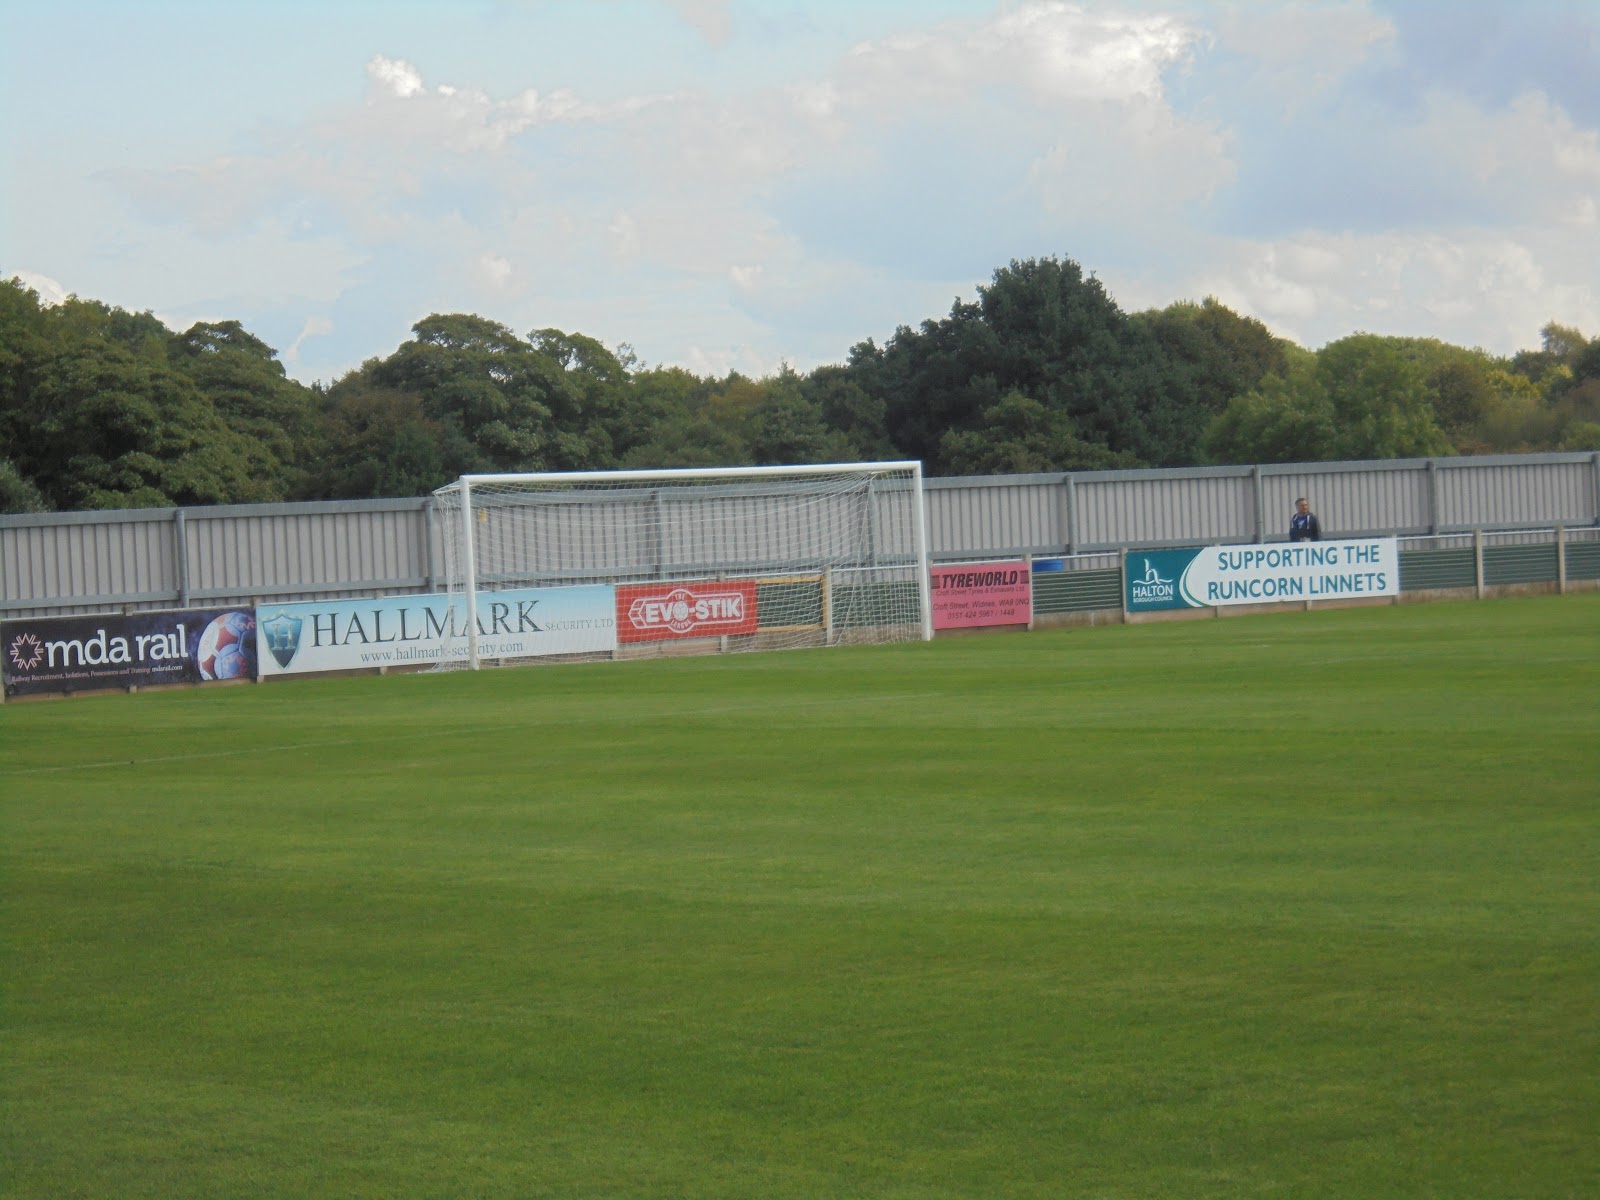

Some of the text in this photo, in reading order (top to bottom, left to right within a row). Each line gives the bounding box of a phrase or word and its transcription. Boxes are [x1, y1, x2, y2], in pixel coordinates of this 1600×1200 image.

[1218, 544, 1380, 571] SUPPORTING THE
[942, 570, 1018, 589] TYREWORLD
[1208, 572, 1386, 600] RUNCORN LINNETS
[951, 588, 967, 596] Street
[969, 588, 983, 596] Tyres
[1132, 584, 1173, 598] HALTON
[645, 597, 741, 623] EVO-STIK
[932, 602, 948, 611] Croft
[999, 599, 1013, 607] WA8
[947, 612, 963, 620] 0151
[965, 611, 977, 619] 424
[1000, 608, 1015, 616] 1448
[545, 618, 614, 632] SECURITY LTD
[45, 624, 189, 667] mda rail
[360, 641, 523, 663] www.hallmark-secrity.com
